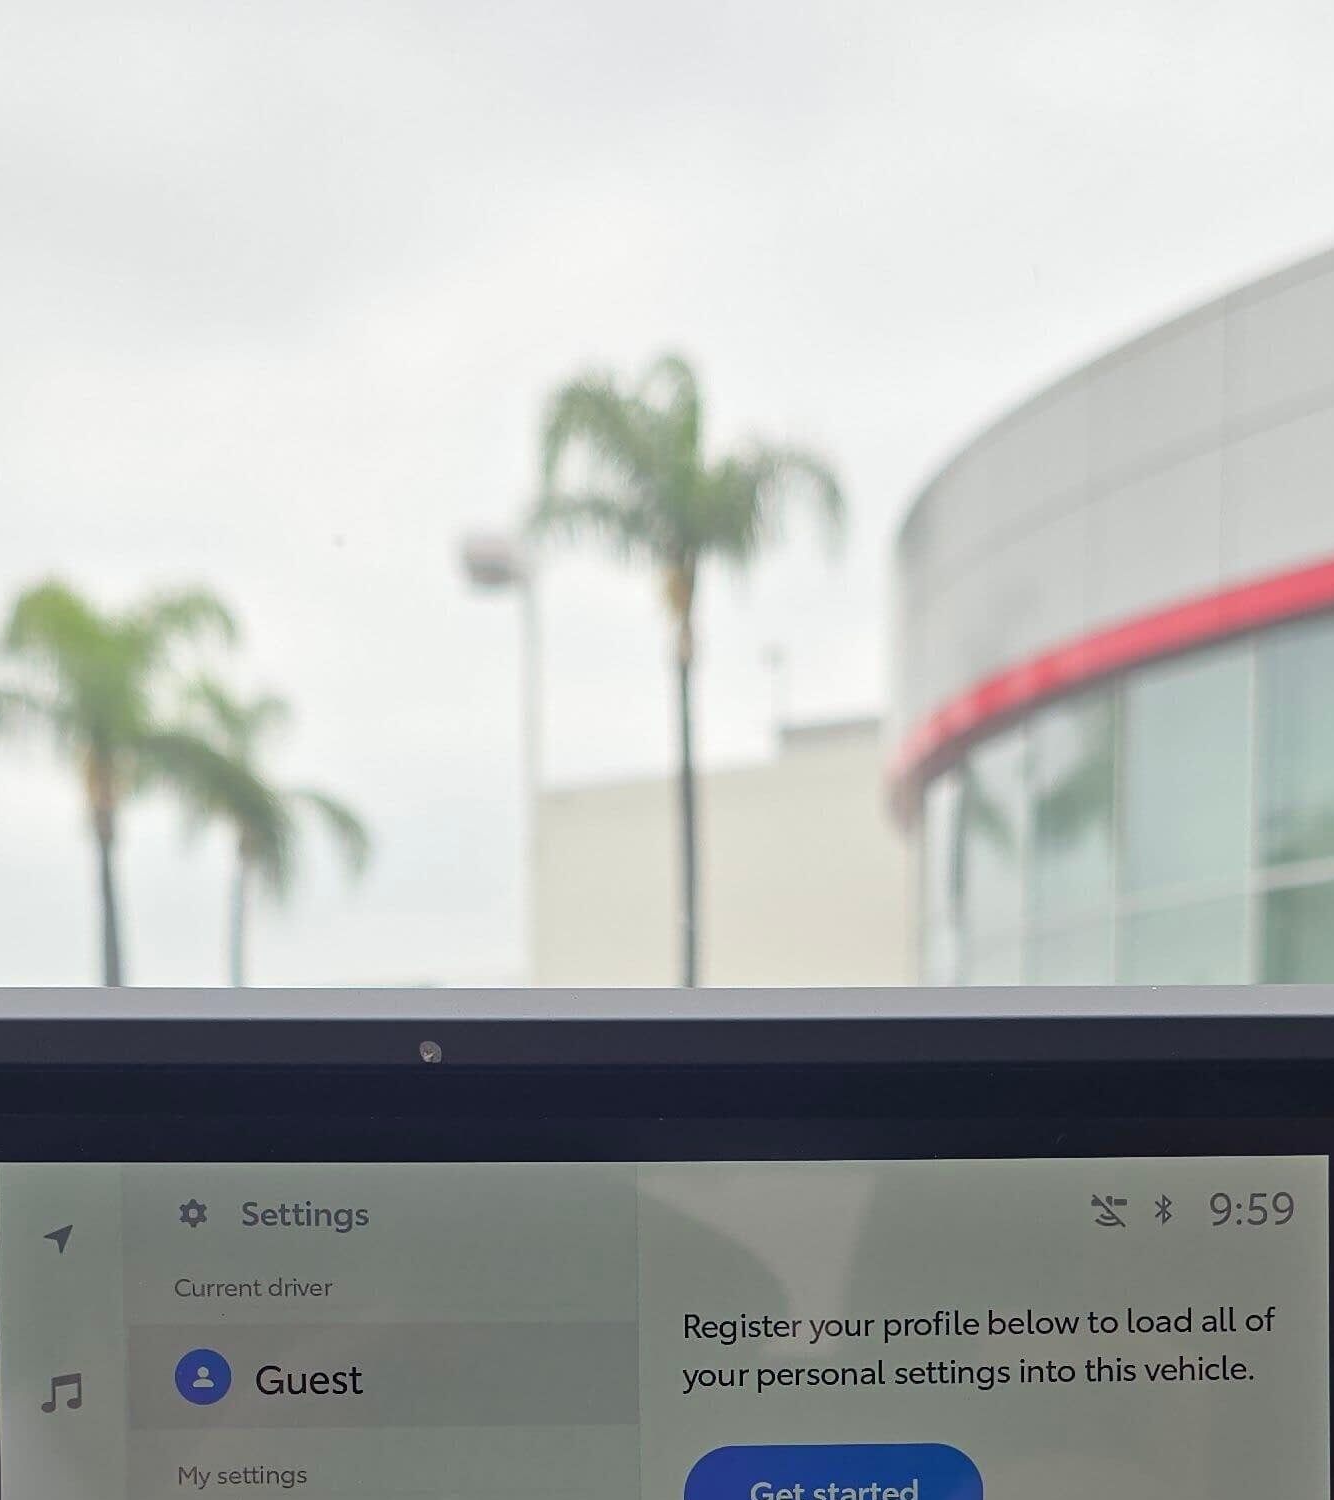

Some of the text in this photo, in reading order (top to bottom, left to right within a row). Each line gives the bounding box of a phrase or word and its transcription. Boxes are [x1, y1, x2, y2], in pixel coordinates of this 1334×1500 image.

[241, 1201, 369, 1233] Settings
[1208, 1191, 1295, 1226] 9:59
[175, 1276, 332, 1298] Current driver
[683, 1306, 1275, 1345] Register your profile below to load all of
[255, 1365, 363, 1396] Guest
[682, 1355, 1254, 1394] your personal settings into this vehicle.
[177, 1465, 307, 1489] My settings
